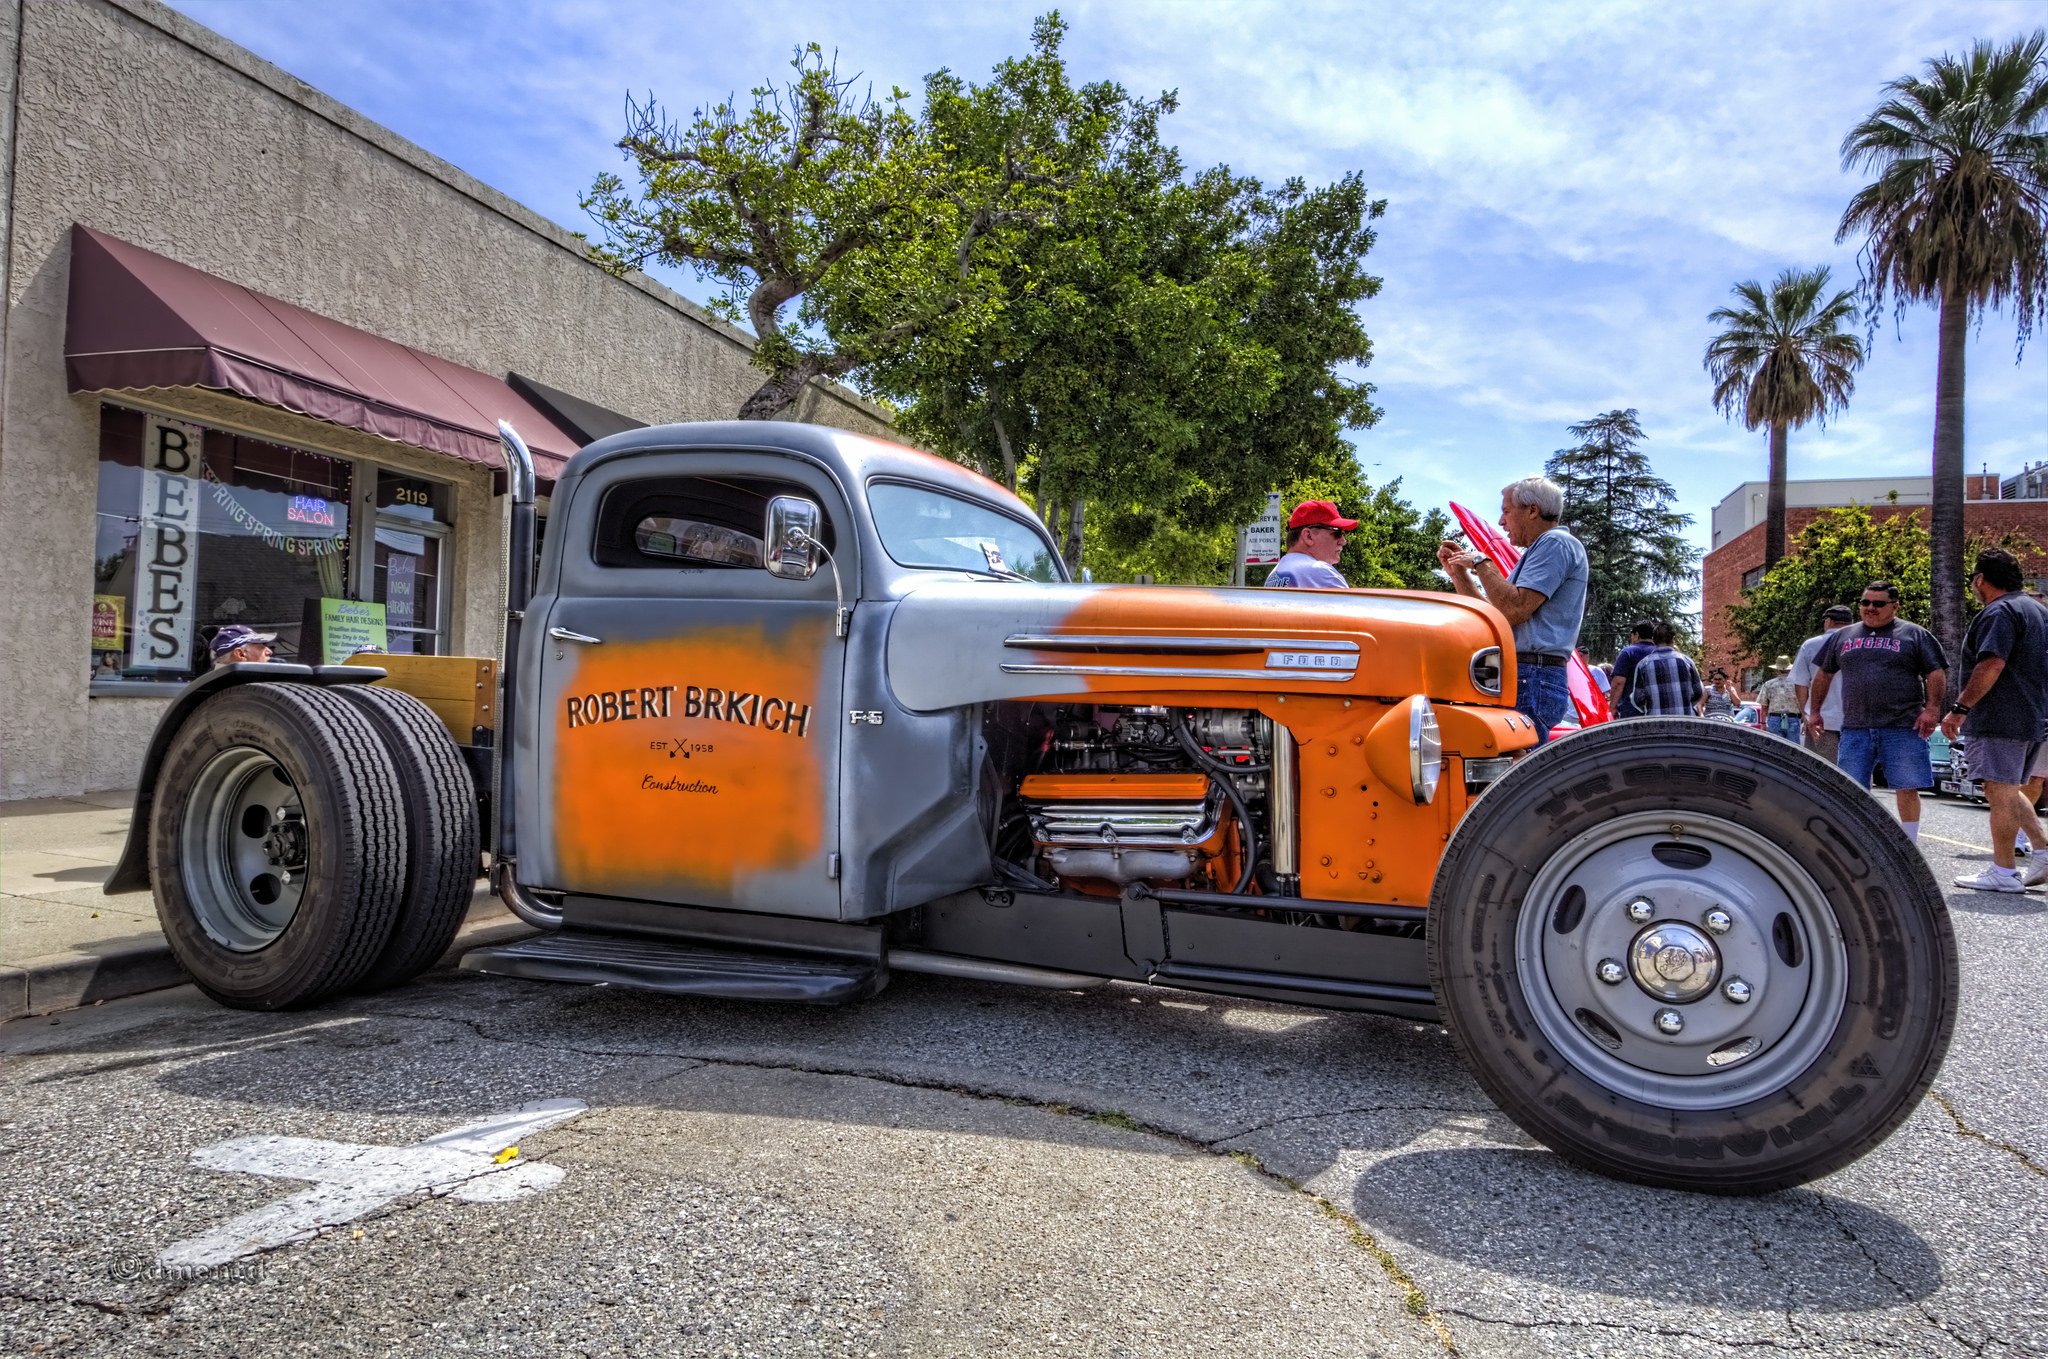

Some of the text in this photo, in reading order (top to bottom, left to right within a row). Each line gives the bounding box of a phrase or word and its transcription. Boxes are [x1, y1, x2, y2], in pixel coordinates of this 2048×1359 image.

[295, 496, 327, 513] HAIR
[396, 487, 428, 505] 2119
[287, 507, 334, 526] SALON
[244, 514, 296, 553] SPRING
[298, 534, 345, 556] SPRING
[1250, 526, 1275, 534] BAKER
[147, 425, 190, 660] BEBES
[390, 581, 411, 595] NOW
[387, 600, 414, 615] HIRING
[325, 613, 384, 627] FAMILY HAIR DESIGNS
[1840, 637, 1901, 656] ANGELS
[1283, 654, 1342, 667] FORD
[567, 686, 813, 738] ROBERT BRKICH
[690, 743, 714, 753] 1958
[641, 773, 719, 795] Construction
